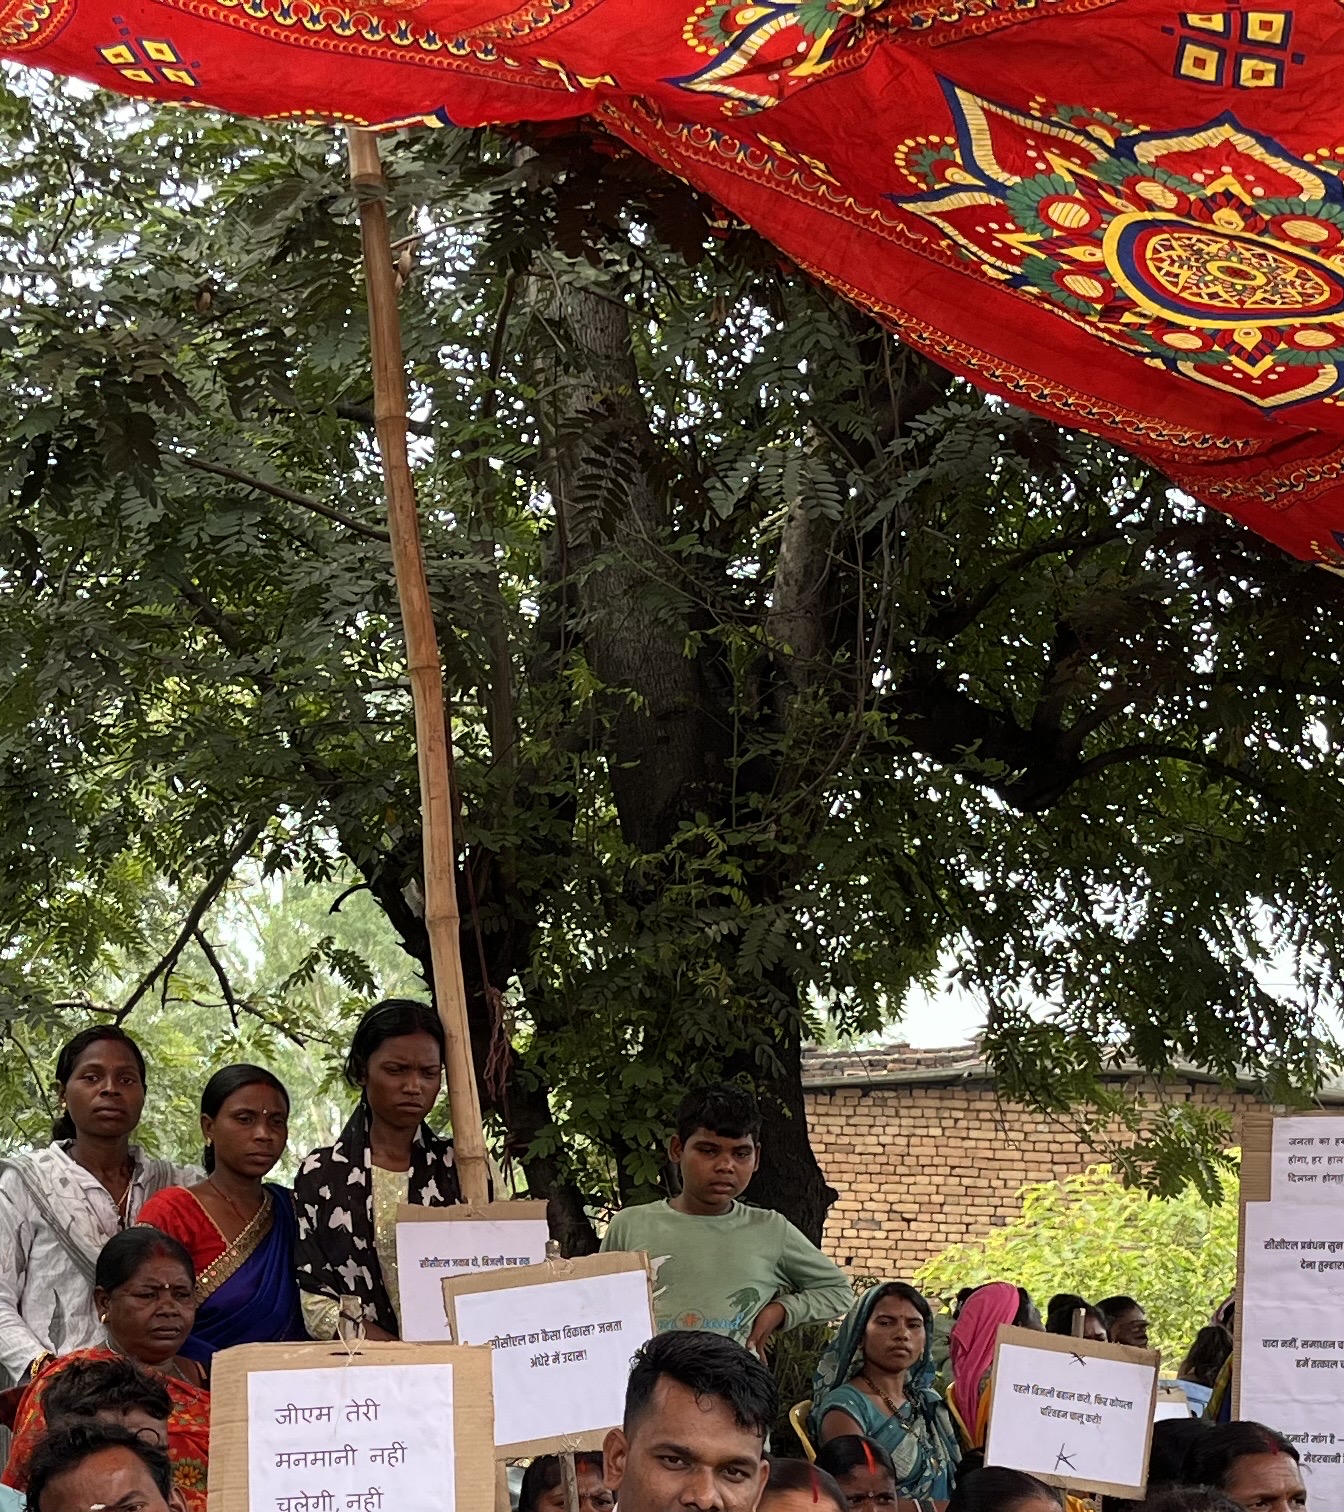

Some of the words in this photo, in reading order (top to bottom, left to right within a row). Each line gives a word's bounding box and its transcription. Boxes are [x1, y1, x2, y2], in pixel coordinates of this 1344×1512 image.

[1288, 1137, 1314, 1146] जनता
[1319, 1137, 1331, 1146] का
[1311, 1155, 1323, 1165] हर
[1327, 1155, 1344, 1165] हाल
[1288, 1172, 1317, 1183] दिलाना
[1264, 1237, 1298, 1250] सीसीएल
[1300, 1238, 1326, 1250] प्रबंधन
[1327, 1240, 1343, 1253] सुन
[481, 1255, 505, 1267] बिजली
[1300, 1258, 1316, 1270] देना
[1318, 1260, 1344, 1273] तुम्हारा
[528, 1332, 539, 1344] का
[541, 1328, 561, 1342] कैसा
[563, 1324, 595, 1340] विकास?
[597, 1320, 622, 1333] जनता
[1262, 1339, 1279, 1348] वादा
[1300, 1339, 1336, 1349] समाधान
[530, 1352, 550, 1368] अंधेरे
[552, 1350, 561, 1365] में
[562, 1349, 587, 1363] उदास!
[1295, 1357, 1311, 1368] हमें
[1311, 1359, 1338, 1369] तत्काल
[1013, 1383, 1030, 1394] पहले
[1032, 1384, 1055, 1398] बिजली
[274, 1403, 334, 1424] जीएम
[345, 1398, 381, 1421] तेरी
[1329, 1432, 1335, 1445] है
[275, 1444, 358, 1469] मनमानी
[369, 1441, 408, 1467] नहीं
[346, 1486, 384, 1512] नहीं
